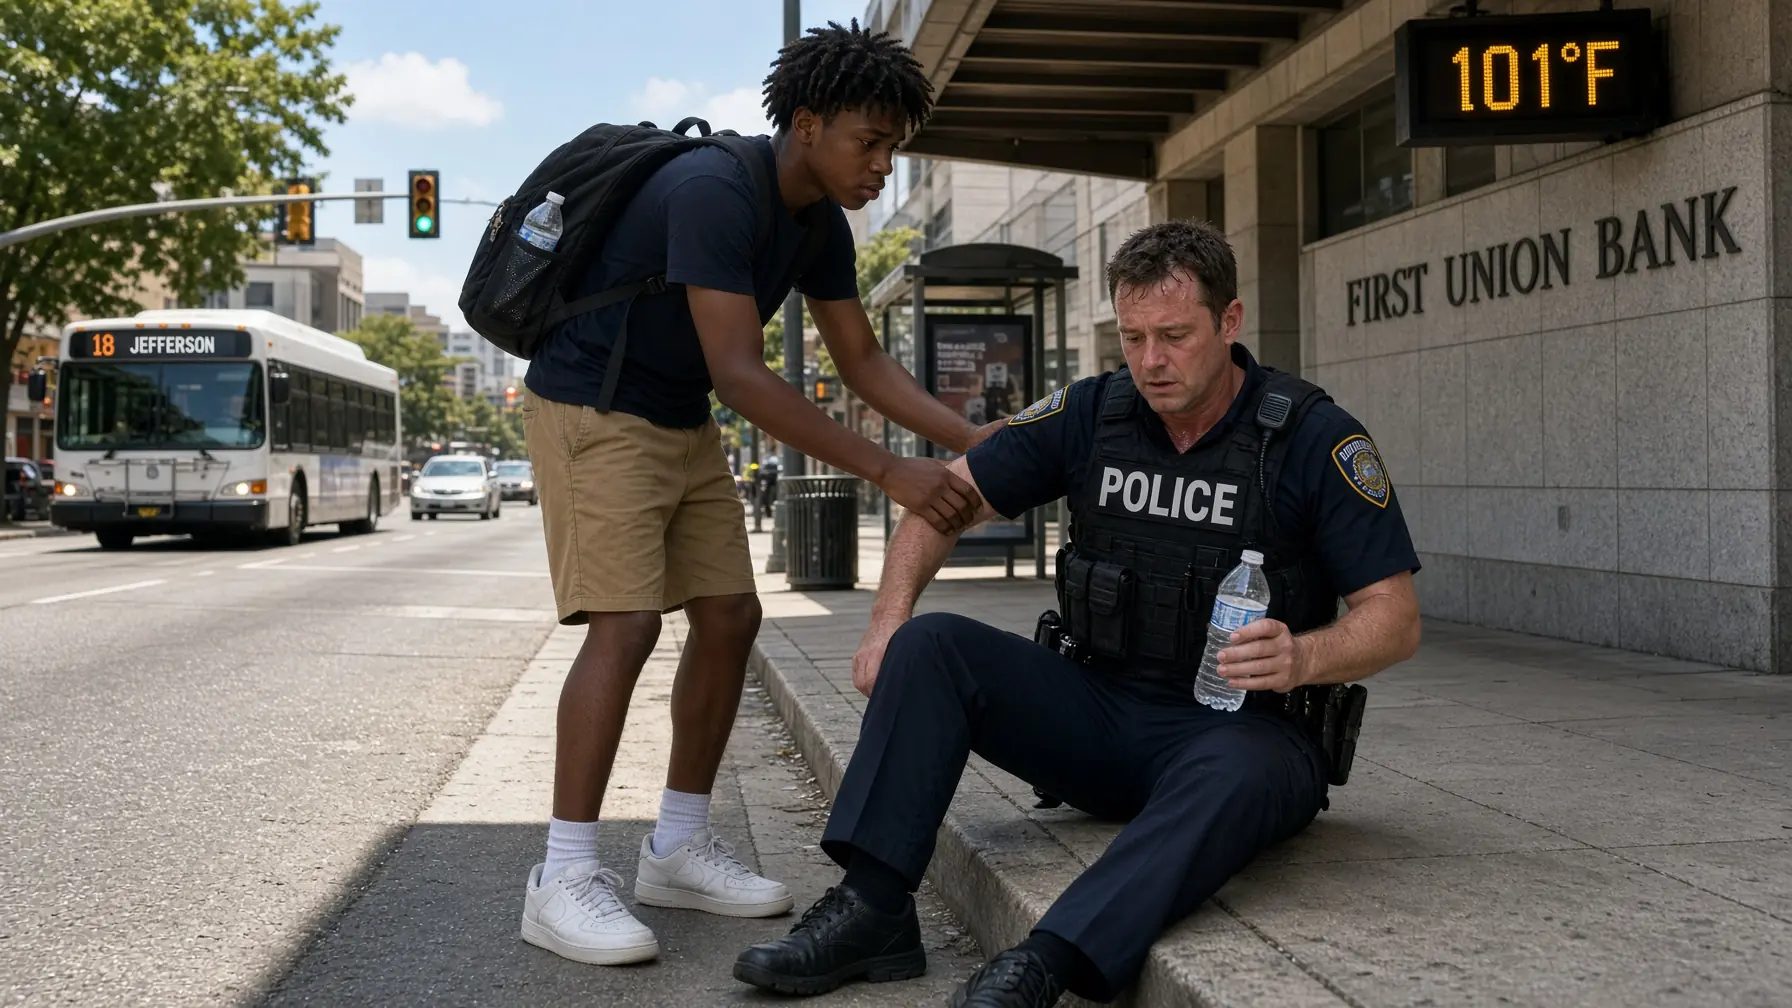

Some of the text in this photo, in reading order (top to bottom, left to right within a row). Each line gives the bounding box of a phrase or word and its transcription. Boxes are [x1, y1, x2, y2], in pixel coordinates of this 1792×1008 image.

[1452, 41, 1619, 111] 101°F
[1346, 186, 1742, 326] FIRST UNION BANK
[92, 333, 215, 356] 18 JEFFERSON
[1098, 466, 1238, 526] POLICE
